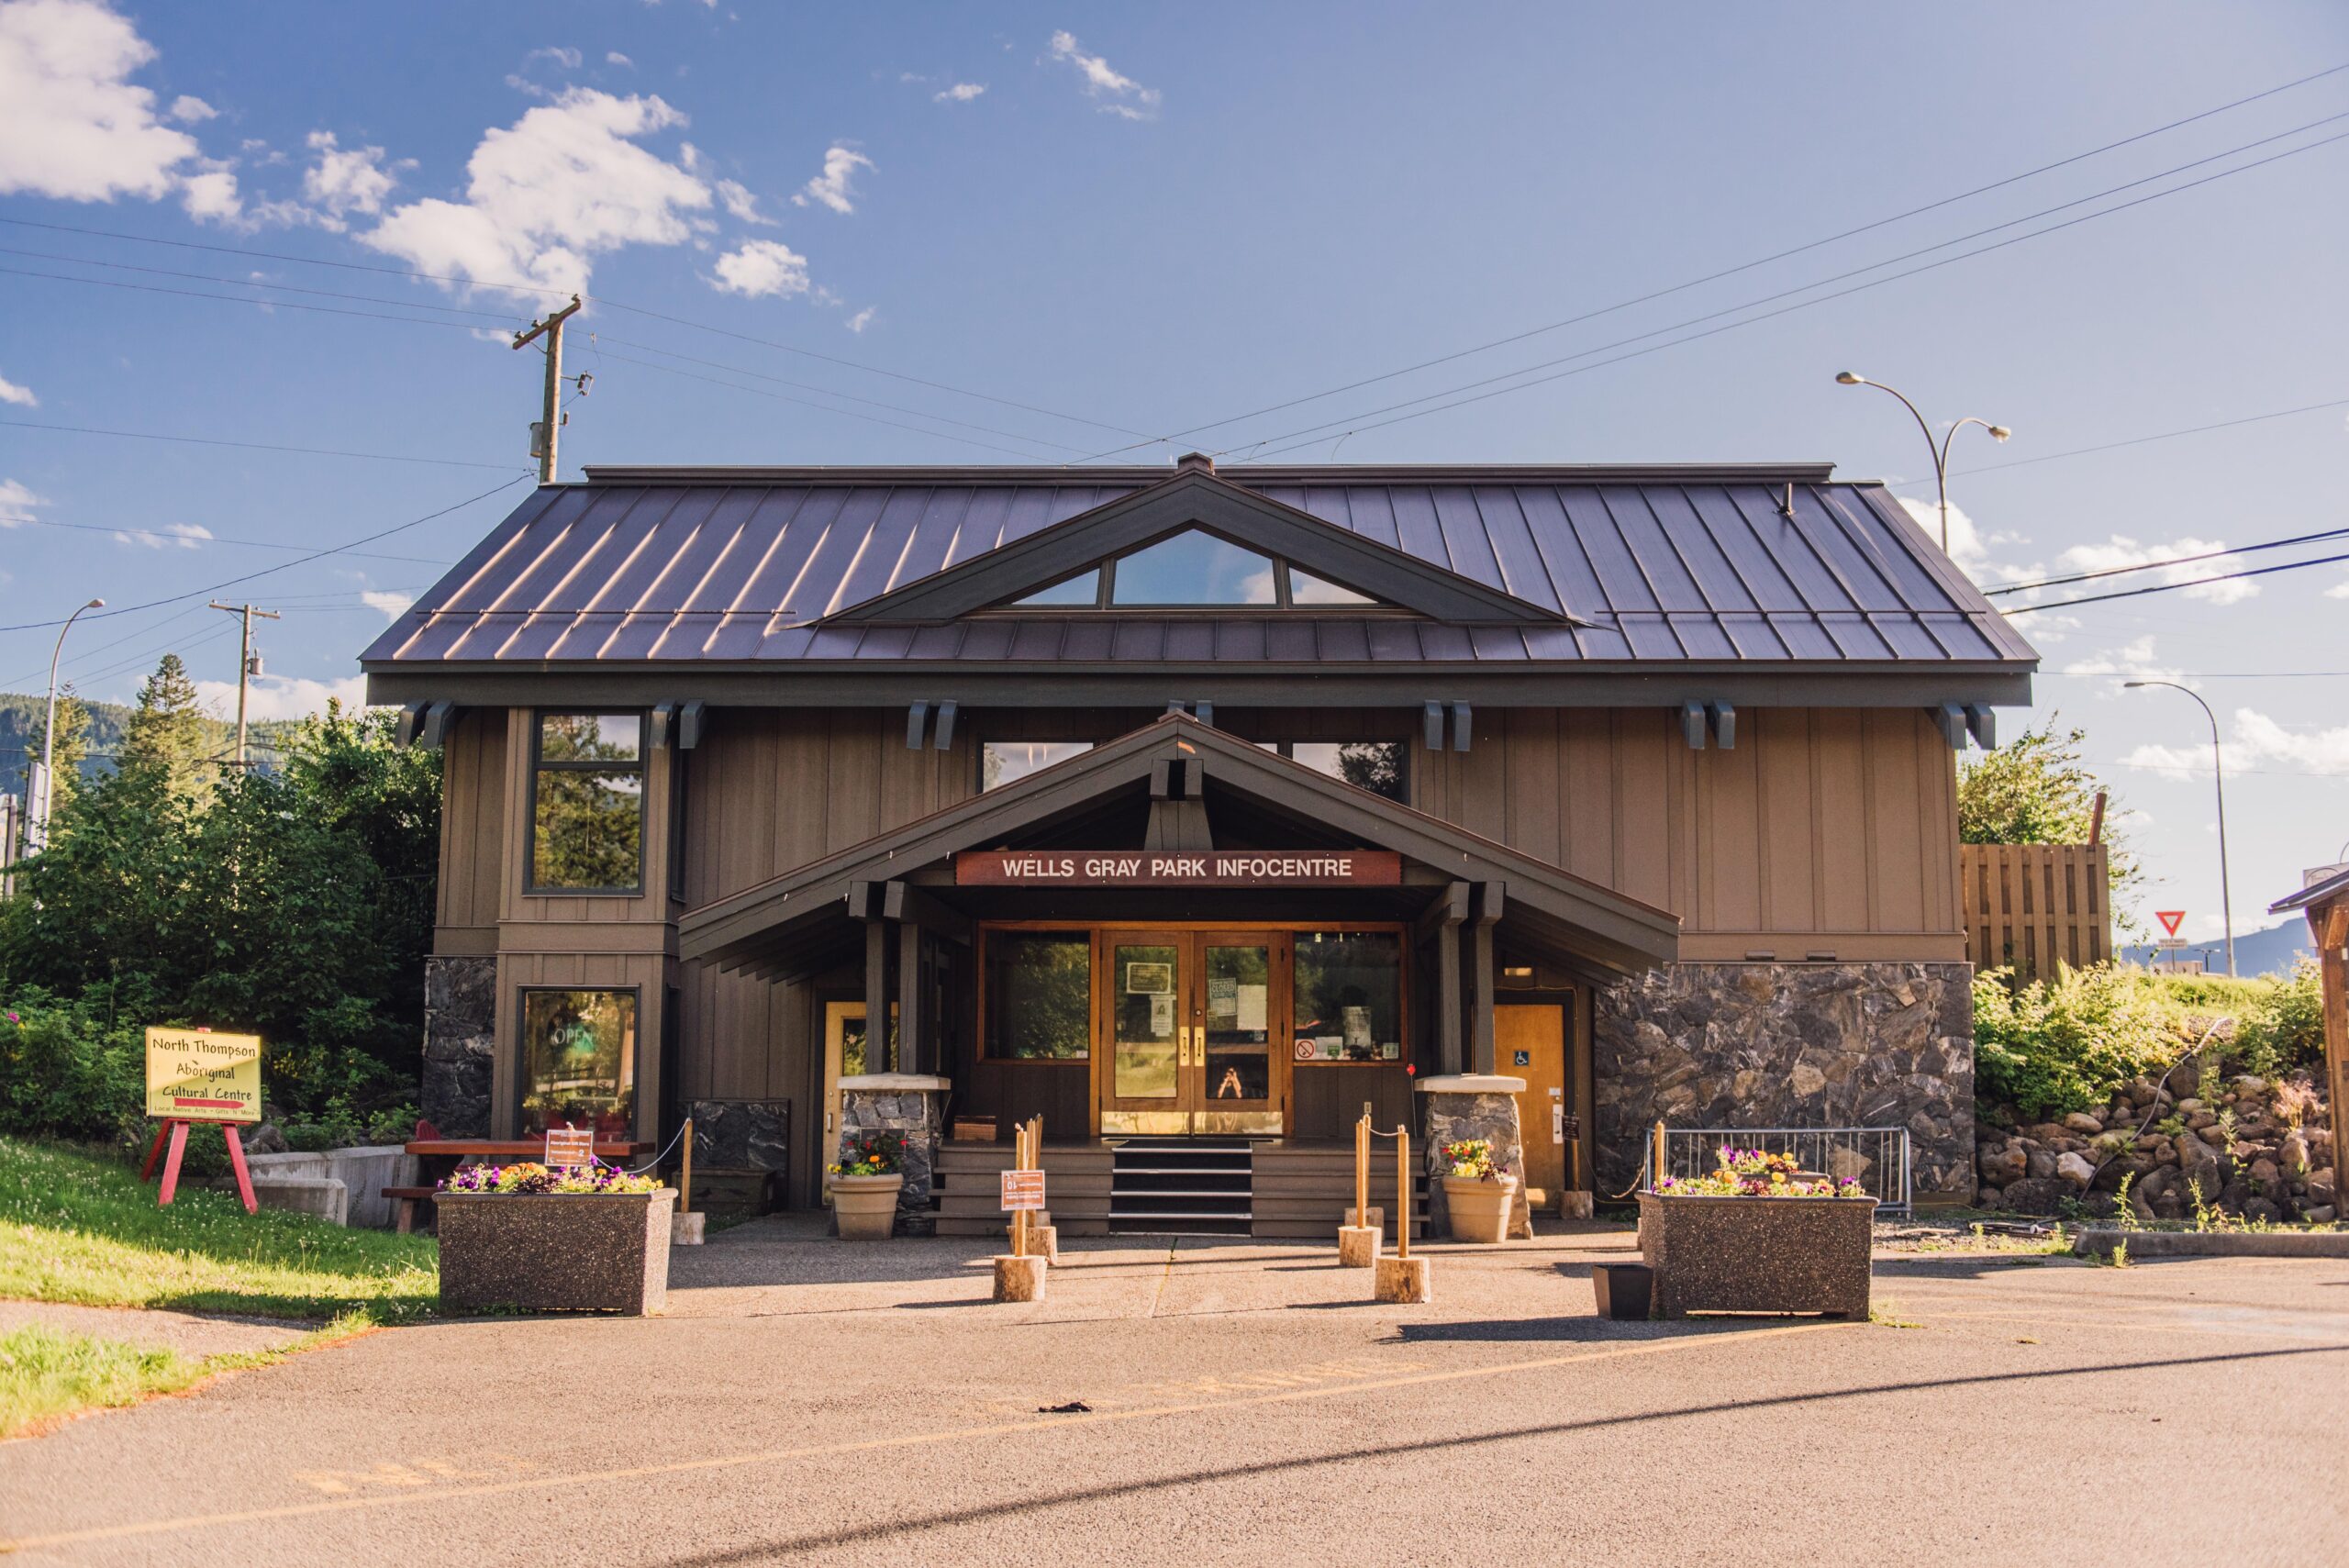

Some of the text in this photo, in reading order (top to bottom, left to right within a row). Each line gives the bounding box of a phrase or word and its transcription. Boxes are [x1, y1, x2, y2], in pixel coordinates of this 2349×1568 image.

[1002, 859, 1353, 877] WELLS GRAY PARK INFOCENTRE
[553, 1028, 593, 1044] OPEN
[152, 1038, 256, 1060] North Thompson
[176, 1062, 235, 1083] Aboriginal
[162, 1086, 252, 1101] Cultural Centre
